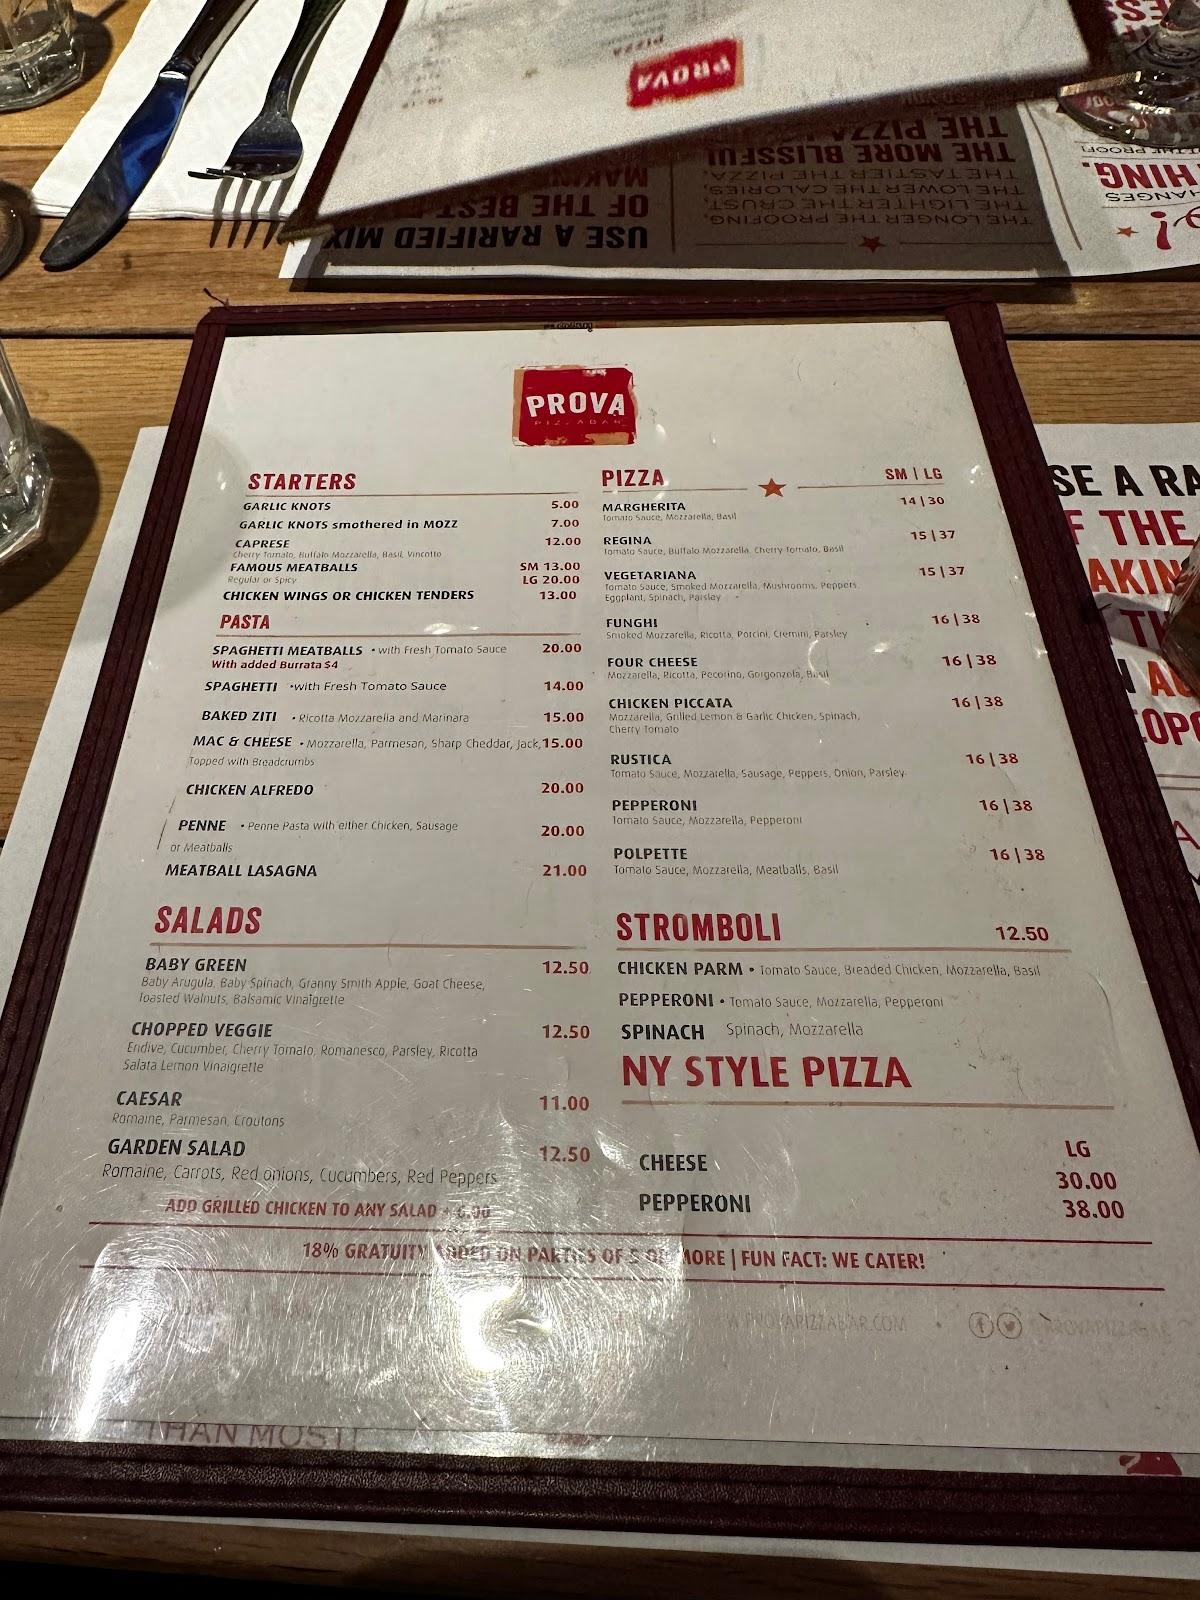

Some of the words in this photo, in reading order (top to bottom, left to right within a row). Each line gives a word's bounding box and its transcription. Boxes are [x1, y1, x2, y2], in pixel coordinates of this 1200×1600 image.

[942, 116, 1008, 140] THE
[857, 143, 942, 163] MORE
[955, 143, 1016, 163] THE
[532, 195, 595, 218] THE
[608, 195, 648, 218] OF
[839, 214, 878, 224] THE
[886, 214, 982, 225] LONGER
[987, 214, 1032, 225] THE
[395, 225, 541, 249] RARIFIED
[556, 225, 572, 248] A
[587, 226, 648, 249] USE
[526, 392, 625, 417] PROVA
[248, 473, 356, 490] STARTERS
[602, 470, 663, 486] PIZZA
[1114, 465, 1144, 496] A
[603, 503, 685, 511] MARGHERITA
[240, 521, 283, 529] GARLIC
[288, 521, 327, 529] KNOTS
[333, 520, 402, 529] smothered
[424, 520, 457, 528] MOZZ
[1099, 510, 1195, 546] THE
[235, 540, 289, 548] CAPRESE
[604, 537, 651, 545] REGINA
[287, 564, 357, 572] MEATBALLS
[544, 562, 580, 570] 13.00
[523, 576, 537, 584] LG
[543, 576, 579, 584] 20.00
[604, 571, 696, 580] VEGETARIANA
[223, 592, 279, 600] CHICKEN
[284, 592, 327, 600] WINGS
[333, 592, 350, 600] OR
[356, 591, 411, 600] CHICKEN
[417, 591, 474, 600] TENDERS
[540, 591, 576, 599] 13.00
[220, 615, 269, 629] PASTA
[607, 619, 657, 627] FUNGHI
[213, 646, 283, 655] SPAGHETTI
[288, 646, 362, 655] MEATBALLS
[543, 644, 581, 653] 20.00
[213, 660, 236, 668] With
[241, 660, 276, 668] added
[608, 658, 643, 667] FOUR
[649, 658, 697, 667] CHEESE
[205, 682, 277, 692] SPAGHETTI
[324, 682, 356, 690] Fresh
[361, 682, 406, 690] Tomato
[409, 682, 446, 690] Sauce
[545, 681, 583, 690] 14.00
[609, 699, 668, 708] CHICKEN
[675, 698, 732, 708] PICCATA
[202, 711, 247, 720] BAKED
[252, 712, 276, 721] ZITI
[299, 714, 334, 722] Ricotta
[339, 713, 394, 722] Mozzarella
[399, 713, 418, 722] and
[423, 714, 468, 722] Marinara
[544, 713, 584, 722] 15.00
[193, 736, 224, 746] MAC
[229, 737, 239, 746] &
[244, 737, 292, 747] CHEESE
[307, 738, 366, 749] Mozzarella,
[372, 740, 427, 749] Parmesan,
[432, 738, 461, 750] Sharp
[466, 739, 512, 750] Cheddar,
[516, 739, 541, 750] Jack,
[543, 738, 582, 748] 15.00
[611, 755, 671, 764] RUSTICA
[187, 784, 246, 795] CHICKEN
[250, 785, 313, 795] ALFREDO
[542, 783, 583, 793] 20.00
[613, 800, 696, 811] PEPPERONI
[179, 820, 226, 831] PENNE
[248, 822, 279, 830] Penne
[283, 822, 309, 830] Pasta
[314, 820, 334, 830] with
[339, 821, 367, 830] either
[372, 821, 412, 831] Chicken,
[417, 822, 457, 832] Sausage
[541, 826, 584, 836] 20.00
[614, 848, 687, 859] POLPETTE
[165, 864, 241, 876] MEATBALL
[248, 865, 317, 876] LASAGNA
[543, 865, 586, 876] 21.00
[614, 865, 651, 874] Tomato
[656, 866, 688, 876] Sauce,
[814, 864, 838, 874] Basil
[155, 906, 261, 934] SALADS
[617, 913, 780, 941] STROMBOLI
[996, 927, 1048, 941] 12.50
[146, 958, 189, 971] BABY
[195, 959, 246, 971] GREEN
[543, 961, 588, 974] 12.50
[618, 962, 687, 975] CHICKEN
[695, 963, 742, 975] PARM
[620, 993, 713, 1006] PEPPERONI
[132, 1022, 208, 1036] CHOPPED
[215, 1023, 272, 1037] VEGGIE
[543, 1025, 589, 1038] 12.50
[622, 1024, 704, 1040] SPINACH
[727, 1023, 784, 1038] Spinach,
[790, 1022, 863, 1036] Mozzarella
[623, 1056, 671, 1086] NY
[686, 1056, 789, 1087] STYLE
[803, 1057, 912, 1087] PIZZA
[117, 1091, 182, 1106] CAESAR
[540, 1096, 589, 1111] 11.00
[112, 1113, 164, 1126] Romaine,
[235, 1116, 284, 1127] Croutons
[108, 1139, 182, 1155] GARDEN
[187, 1140, 245, 1156] SALAD
[540, 1146, 590, 1162] 12.50
[1065, 1141, 1090, 1157] LG
[640, 1154, 707, 1171] CHEESE
[103, 1164, 166, 1180] Romaine,
[174, 1165, 224, 1182] Carrots,
[232, 1166, 258, 1180] Red
[264, 1168, 312, 1184] onions,
[320, 1168, 400, 1186] Cucumbers,
[408, 1168, 433, 1183] Red
[441, 1170, 497, 1188] Peppers
[1056, 1172, 1116, 1190] 30.00
[165, 1199, 197, 1213] ADD
[202, 1200, 259, 1214] GRILLED
[266, 1201, 327, 1215] CHICKEN
[332, 1203, 349, 1216] TO
[354, 1203, 385, 1216] ANY
[390, 1203, 436, 1218] SALAD
[640, 1194, 750, 1212] PEPPERONI
[1063, 1200, 1124, 1218] 38.00
[302, 1243, 339, 1258] 18%
[741, 1251, 776, 1267] FUN
[782, 1252, 827, 1268] FACT:
[832, 1252, 862, 1269] WE
[865, 1253, 925, 1270] CATER!
